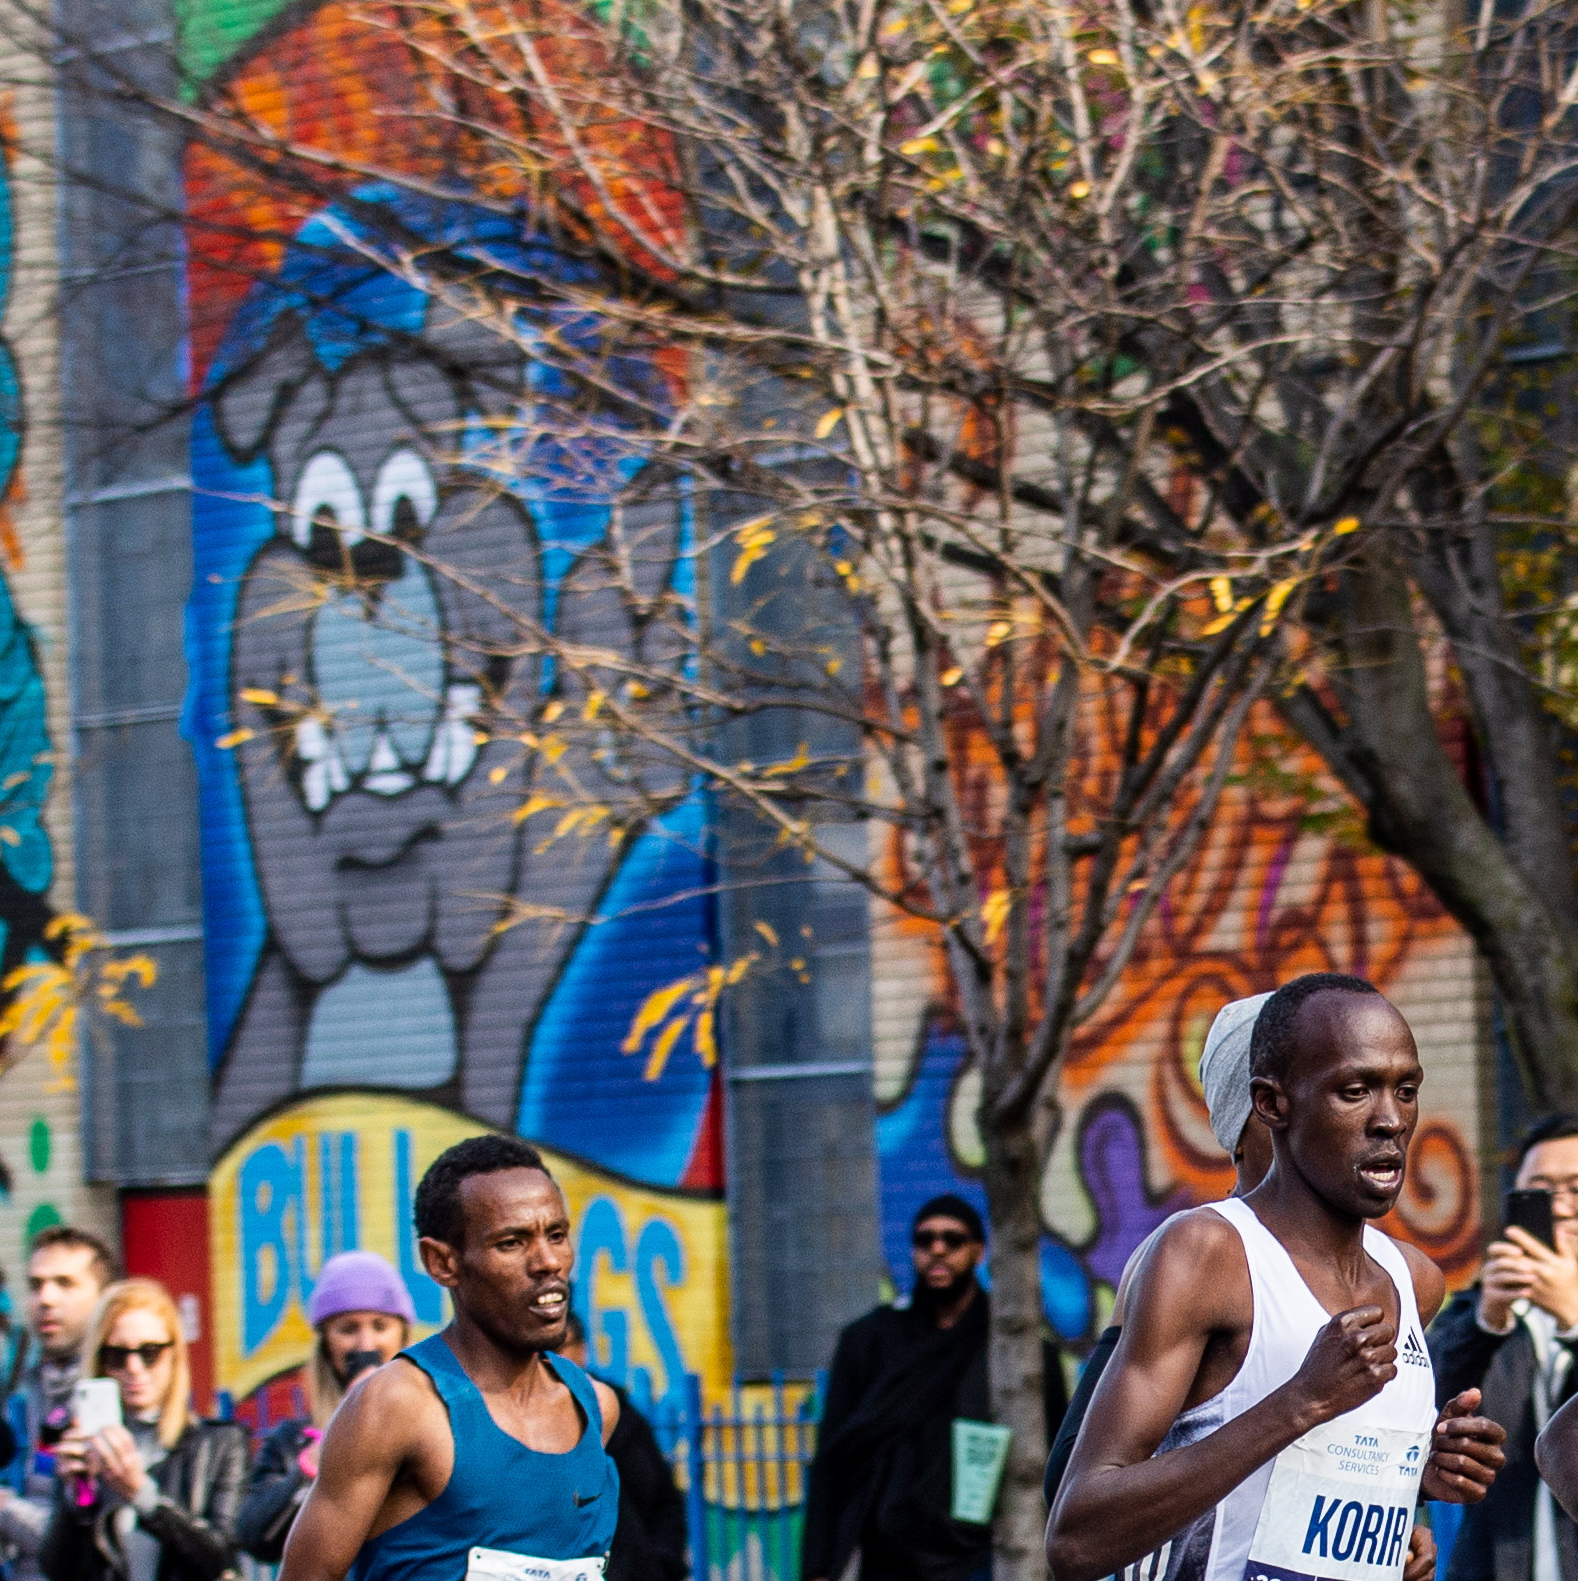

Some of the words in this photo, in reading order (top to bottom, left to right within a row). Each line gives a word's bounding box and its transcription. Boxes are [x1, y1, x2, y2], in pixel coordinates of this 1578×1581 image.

[1355, 1435, 1379, 1448] TATA
[1327, 1443, 1389, 1463] CONSULTANCY
[1338, 1460, 1379, 1476] SERVICES
[1302, 1494, 1408, 1567] KORIR
